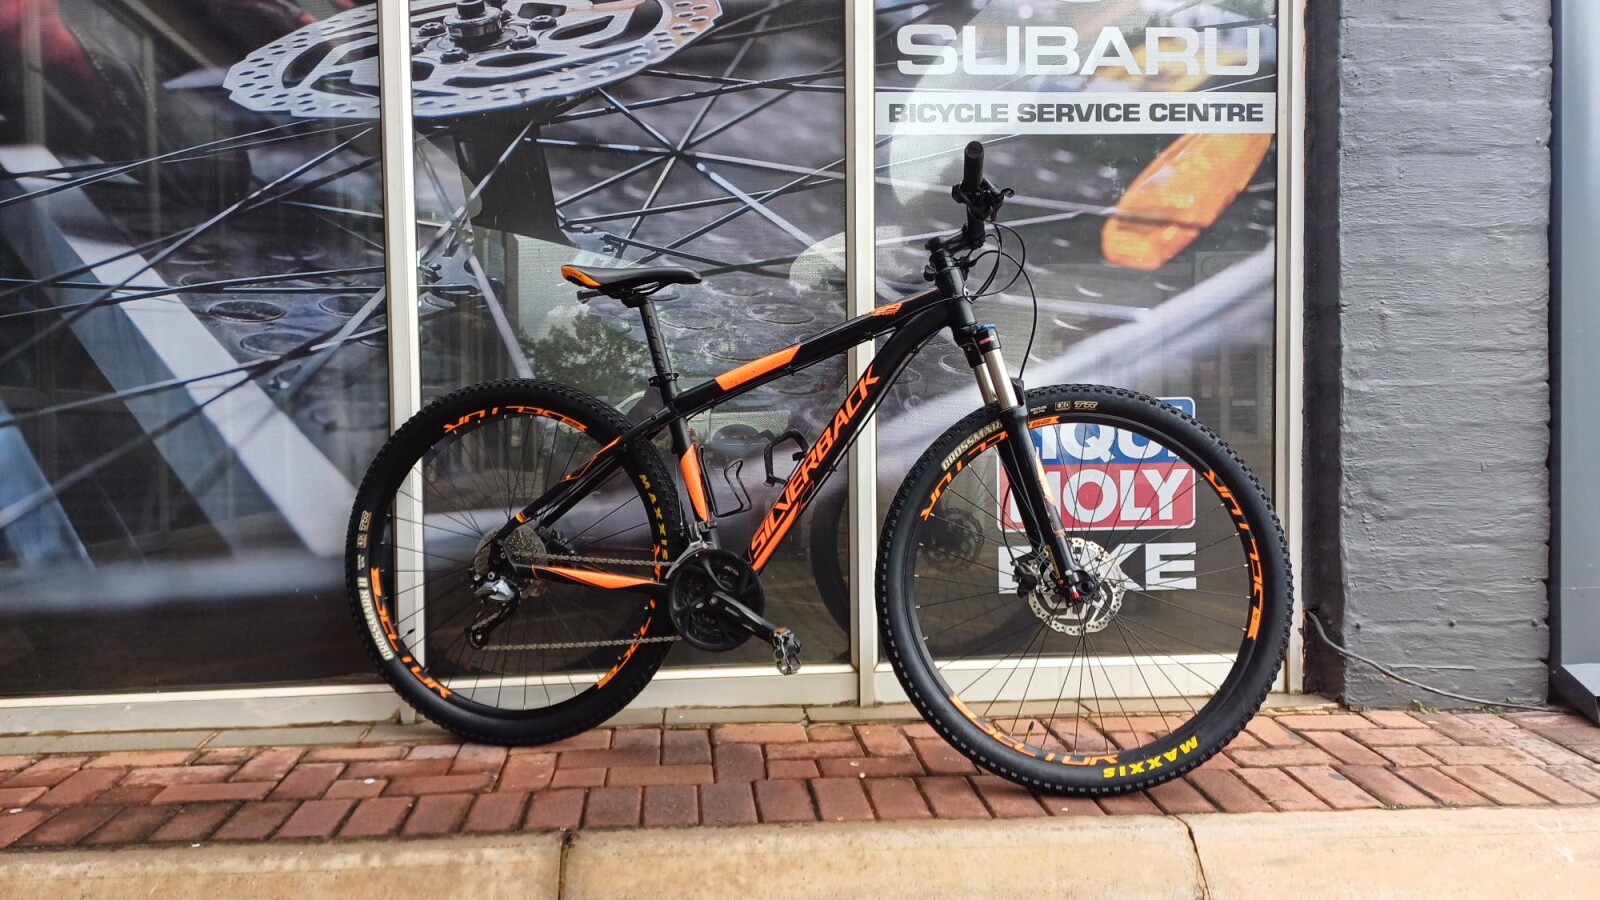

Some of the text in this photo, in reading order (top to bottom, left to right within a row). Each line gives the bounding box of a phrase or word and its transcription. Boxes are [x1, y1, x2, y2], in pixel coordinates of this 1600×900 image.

[896, 24, 1261, 77] SUBARU
[888, 103, 1264, 124] BICYCLE SERVICE CENTRE
[941, 419, 1003, 472] CROSSMAR
[1028, 404, 1184, 463] IQU
[751, 363, 881, 559] SILVERBACK
[639, 474, 669, 561] MAXXIS
[1010, 468, 1190, 523] MOLY
[998, 542, 1197, 595] KE
[1103, 734, 1199, 779] MAXXIS
